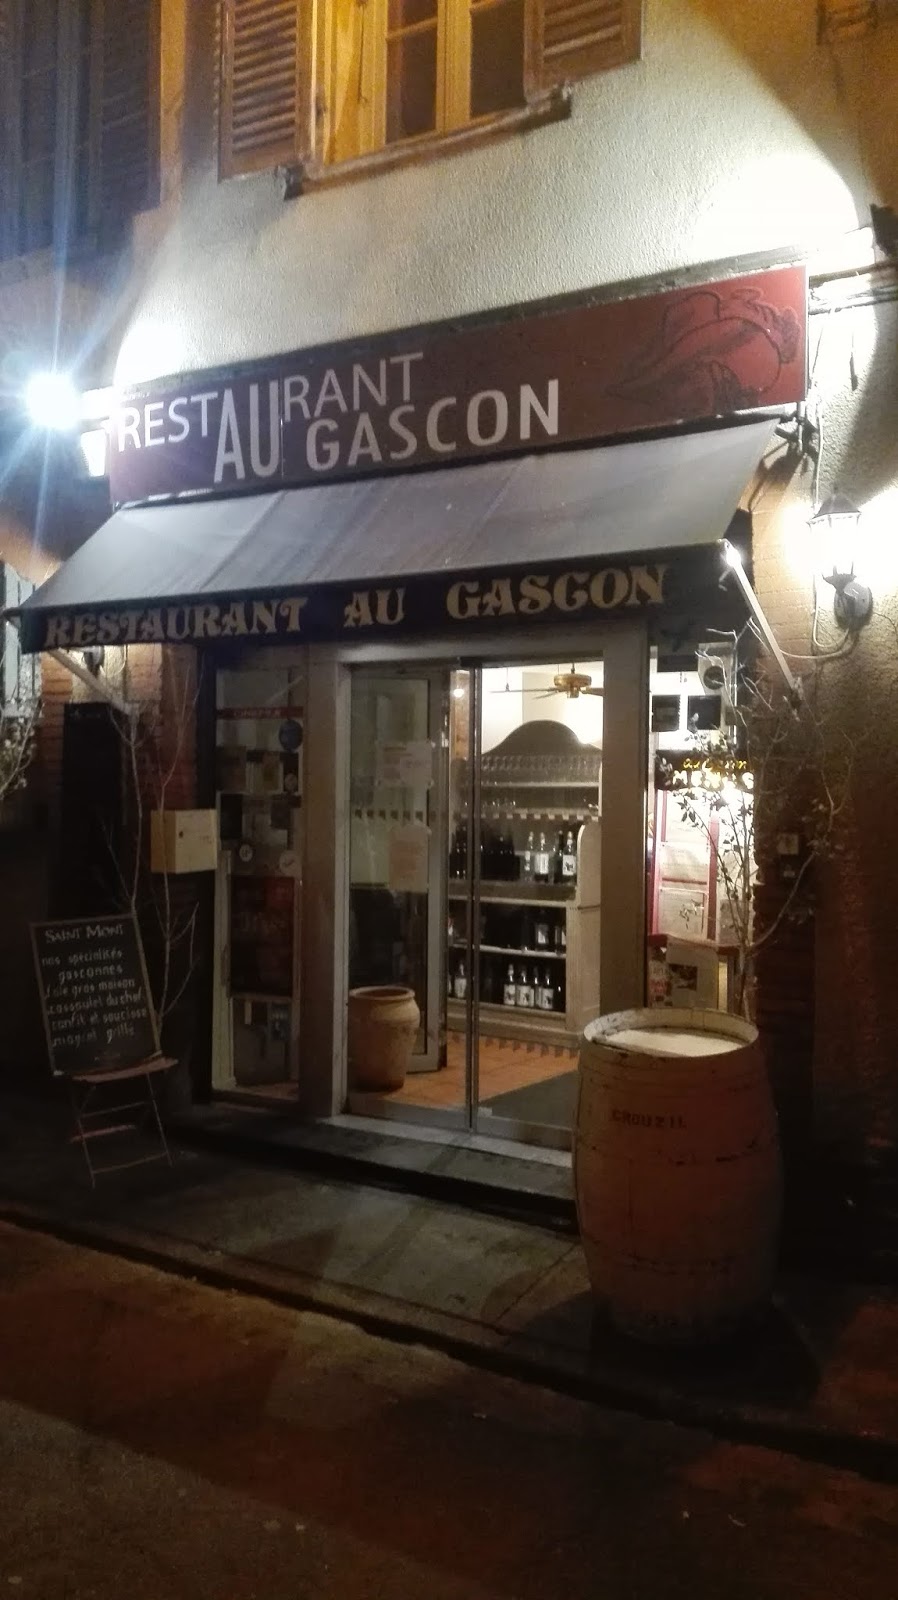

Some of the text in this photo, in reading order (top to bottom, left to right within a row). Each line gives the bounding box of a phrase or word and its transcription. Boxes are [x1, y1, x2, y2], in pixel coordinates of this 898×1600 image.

[306, 378, 560, 472] GASCON
[45, 563, 669, 647] RESTAURANT AU GASCON
